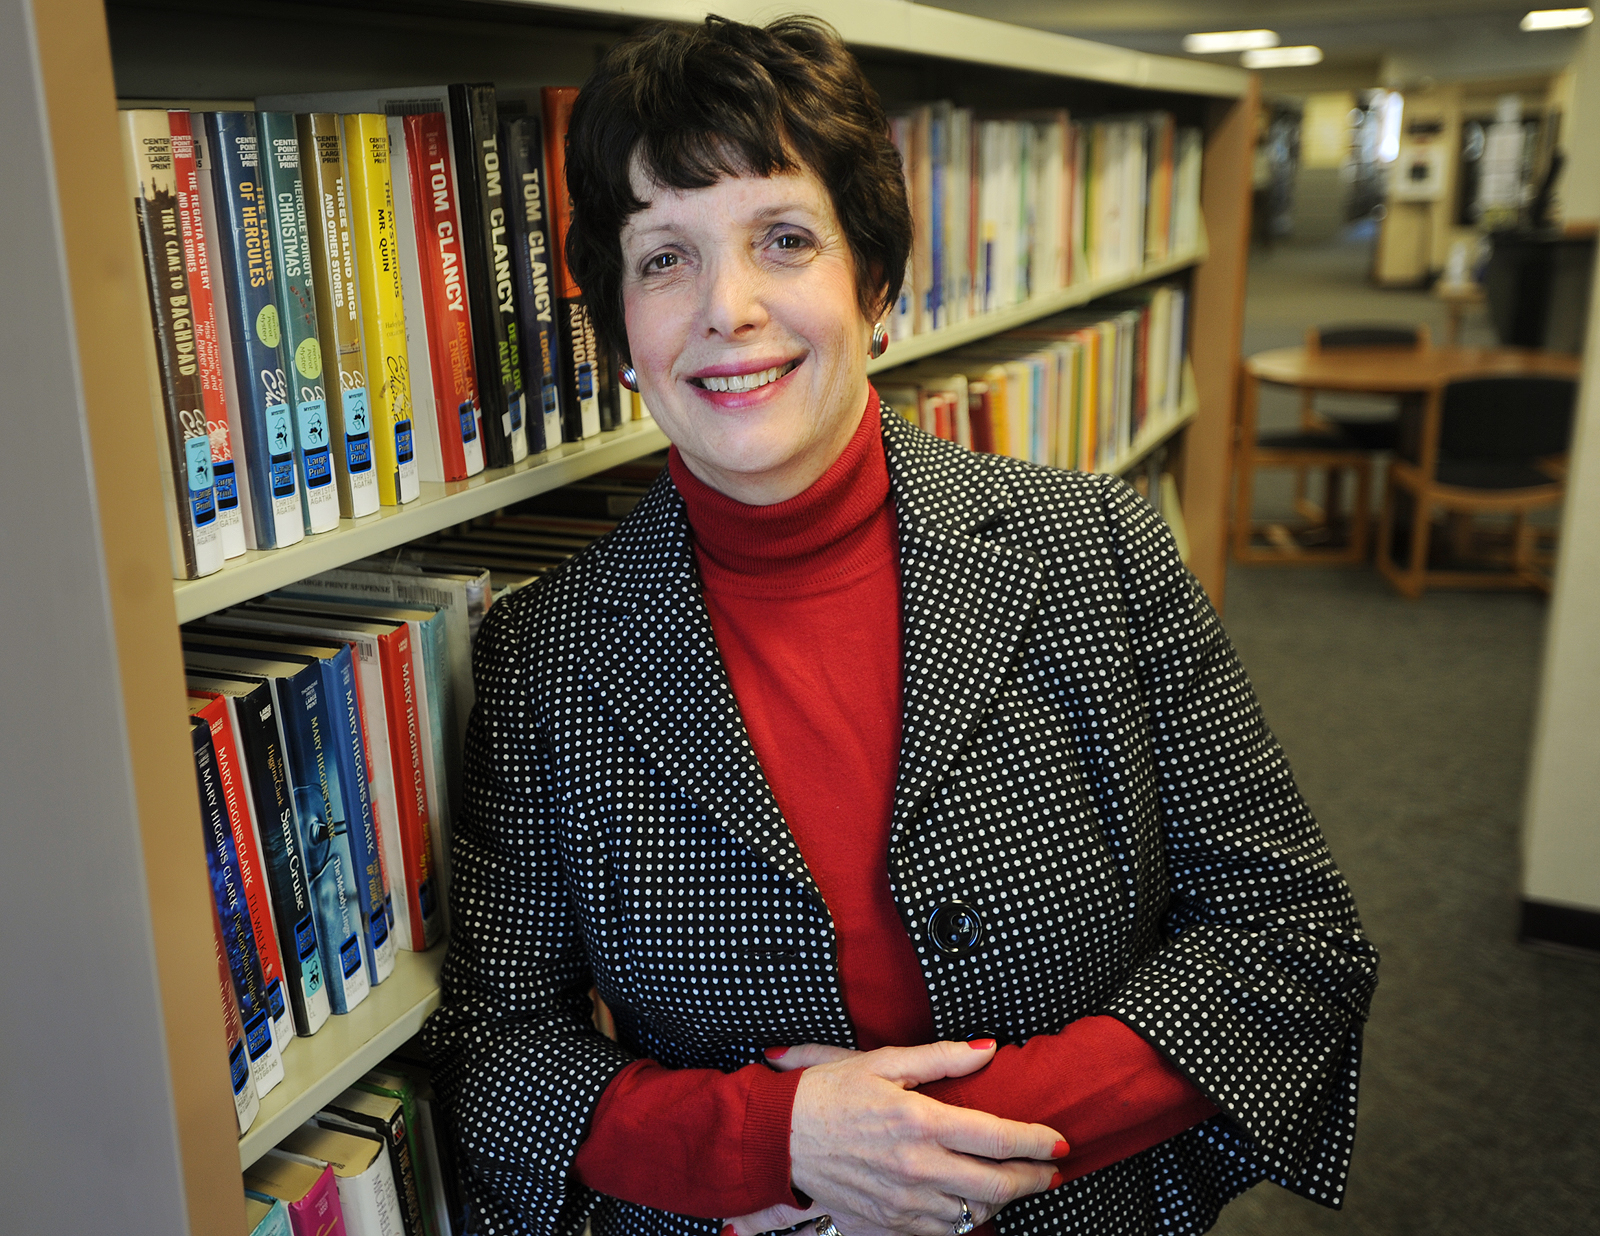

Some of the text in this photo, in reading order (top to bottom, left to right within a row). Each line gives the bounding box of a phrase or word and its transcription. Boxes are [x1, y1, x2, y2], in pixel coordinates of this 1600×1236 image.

[143, 137, 171, 145] CENTER
[483, 133, 502, 197] TOM
[430, 158, 449, 212] TOM
[178, 191, 197, 273] AND OTHER STORIES
[188, 171, 210, 289] THE REGATTA MYSTERY
[239, 181, 265, 287] OF HERCULES
[256, 187, 274, 281] THE LABORS
[278, 193, 301, 277] CHRISTMAS
[294, 180, 312, 287] HERCULE POIROT'S
[325, 193, 344, 308] AND OTHER STORIES
[336, 177, 357, 320] THREE BLIND MICE
[378, 209, 390, 272] MR. QUIN
[388, 211, 400, 298] MYSTERIOUS
[522, 168, 552, 322] TOM CLANCY
[438, 220, 463, 311] CLANCY
[490, 207, 514, 313] CLANCY
[161, 207, 197, 376] THEY CAME TO BAGHDAD
[196, 324, 210, 390] Mr. Parker Pyne
[206, 341, 215, 372] Marple,
[448, 339, 464, 396] ENEMIES
[457, 321, 472, 372] AGAINST
[499, 340, 513, 385] ALIVE
[508, 322, 519, 366] DEAD
[307, 454, 328, 467] Large
[350, 442, 369, 454] Large
[351, 451, 367, 463] Print
[397, 433, 411, 444] Large
[399, 443, 410, 454] Print
[194, 487, 213, 501] Large
[274, 463, 292, 476] Large
[275, 474, 290, 486] Print
[308, 465, 327, 477] Print
[309, 483, 335, 497] CHRISTIE
[195, 500, 211, 513] Print
[310, 495, 332, 506] AGATHA
[325, 580, 349, 590] PRINT
[351, 583, 391, 593] SUSPENSE
[402, 662, 413, 704] MARY
[210, 717, 223, 731] LARGE
[211, 724, 224, 737] PRINT
[407, 706, 420, 769] HIGGINS
[311, 716, 336, 840] MARY HIGGINS CLARK
[346, 690, 357, 735] MARY
[352, 737, 367, 803] HIGGINS
[361, 802, 374, 855] CLARK
[413, 769, 425, 817] CLARK
[202, 767, 217, 807] MARY
[211, 808, 228, 865] HIGGINS
[222, 865, 238, 910] CLARK
[218, 747, 253, 889] MARY HIGGINS CLARK
[280, 808, 304, 911] Santa Cruise
[333, 855, 347, 910] The Melody
[233, 912, 258, 1002] I've Got You Under
[253, 916, 267, 955] WALK
[248, 1023, 266, 1043] Large
[250, 1033, 266, 1053] Print
